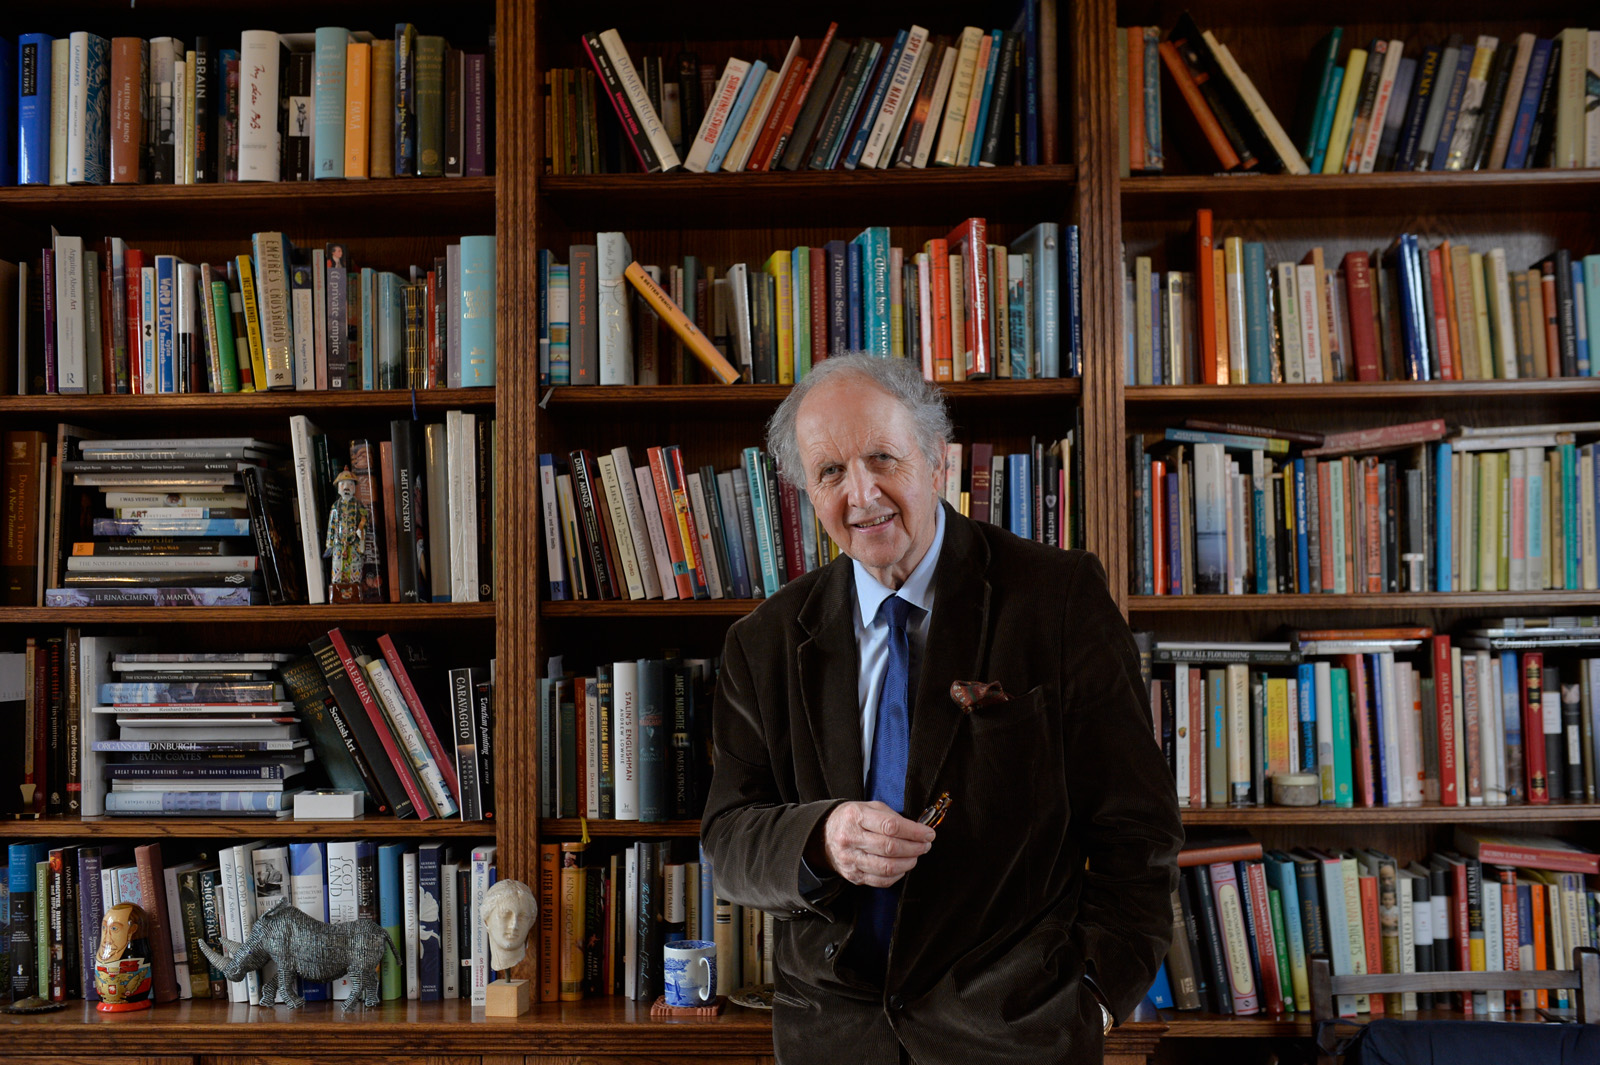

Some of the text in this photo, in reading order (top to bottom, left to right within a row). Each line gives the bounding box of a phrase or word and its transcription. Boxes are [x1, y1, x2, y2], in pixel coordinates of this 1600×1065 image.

[197, 58, 206, 98] BRAIN
[716, 76, 740, 112] SURVIVING
[883, 38, 921, 115] SPY WITH 29 NAMES
[1382, 80, 1392, 92] The
[124, 112, 130, 120] OF
[350, 100, 360, 130] EMMA
[616, 57, 660, 138] DUMBSTRUCK
[836, 86, 853, 114] Eminent
[1372, 94, 1390, 131] Merchants
[704, 118, 722, 144] SWORD
[822, 116, 841, 150] Canadians
[1366, 142, 1378, 157] Fear
[69, 248, 78, 276] Arguing
[974, 225, 987, 320] Professional Savages
[159, 278, 172, 332] WORD PLAY
[266, 240, 286, 343] EMPIRE'S CROSSROADS
[834, 260, 844, 322] Promise Seed
[1304, 290, 1314, 330] FORGOTTEN
[330, 282, 342, 355] private empire
[1046, 290, 1056, 344] First Bite
[400, 468, 412, 532] LORENZO LIPPI
[573, 458, 590, 508] DIRTY MINDS
[16, 474, 28, 561] DOMENICO TIEPOLO
[130, 510, 148, 518] ART
[623, 482, 650, 571] KEEPING MARBLES
[768, 480, 778, 532] SELF-KNOWLEDGE
[8, 514, 16, 548] Testament
[1046, 512, 1056, 546] metaph
[592, 546, 607, 583] KAYT SUKEL
[627, 560, 635, 576] FORD
[96, 594, 102, 602] IL
[103, 594, 158, 602] RINASCIMENTO
[166, 594, 202, 602] MANTOVA
[69, 665, 78, 704] Knowledge
[344, 658, 372, 705] RAEBURN
[374, 671, 416, 748] Pilot Cutters Under Sail
[456, 677, 469, 738] CARAVAGGIO
[480, 697, 490, 756] Venetian painting
[1441, 703, 1452, 740] CURSED
[70, 725, 78, 746] David
[328, 706, 356, 753] Scottish Art
[600, 706, 610, 774] AMERICAN MUSICAL
[674, 674, 685, 802] JAMES NAUGHTIE PARIS SPRING
[70, 747, 78, 777] Hockney
[131, 753, 162, 761] KEVIN
[1445, 742, 1453, 768] PLACES
[140, 864, 148, 898] EVERYDAY
[236, 866, 247, 908] OXFORD
[329, 856, 342, 897] LAND
[340, 856, 354, 898] SCOT
[361, 866, 372, 906] Britain's
[642, 882, 650, 892] The
[1468, 867, 1477, 905] HOMER
[89, 873, 101, 934] Royal Subjects
[204, 881, 216, 939] SHOCK FALL
[542, 868, 553, 932] AFTER THE PARTY
[565, 876, 575, 936] KING PEGGY
[641, 893, 651, 914] Death
[1254, 868, 1270, 936] MICHELANGELO
[1344, 876, 1361, 955] ARCADIAN NIGHTS
[186, 903, 200, 964] Robert Burns
[640, 924, 651, 954] Sigmund
[1232, 908, 1243, 949] BLOOMSBURY
[1238, 950, 1248, 983] COOKBOOK
[1403, 894, 1412, 971] THE ODYSSE
[640, 955, 651, 978] Freud
